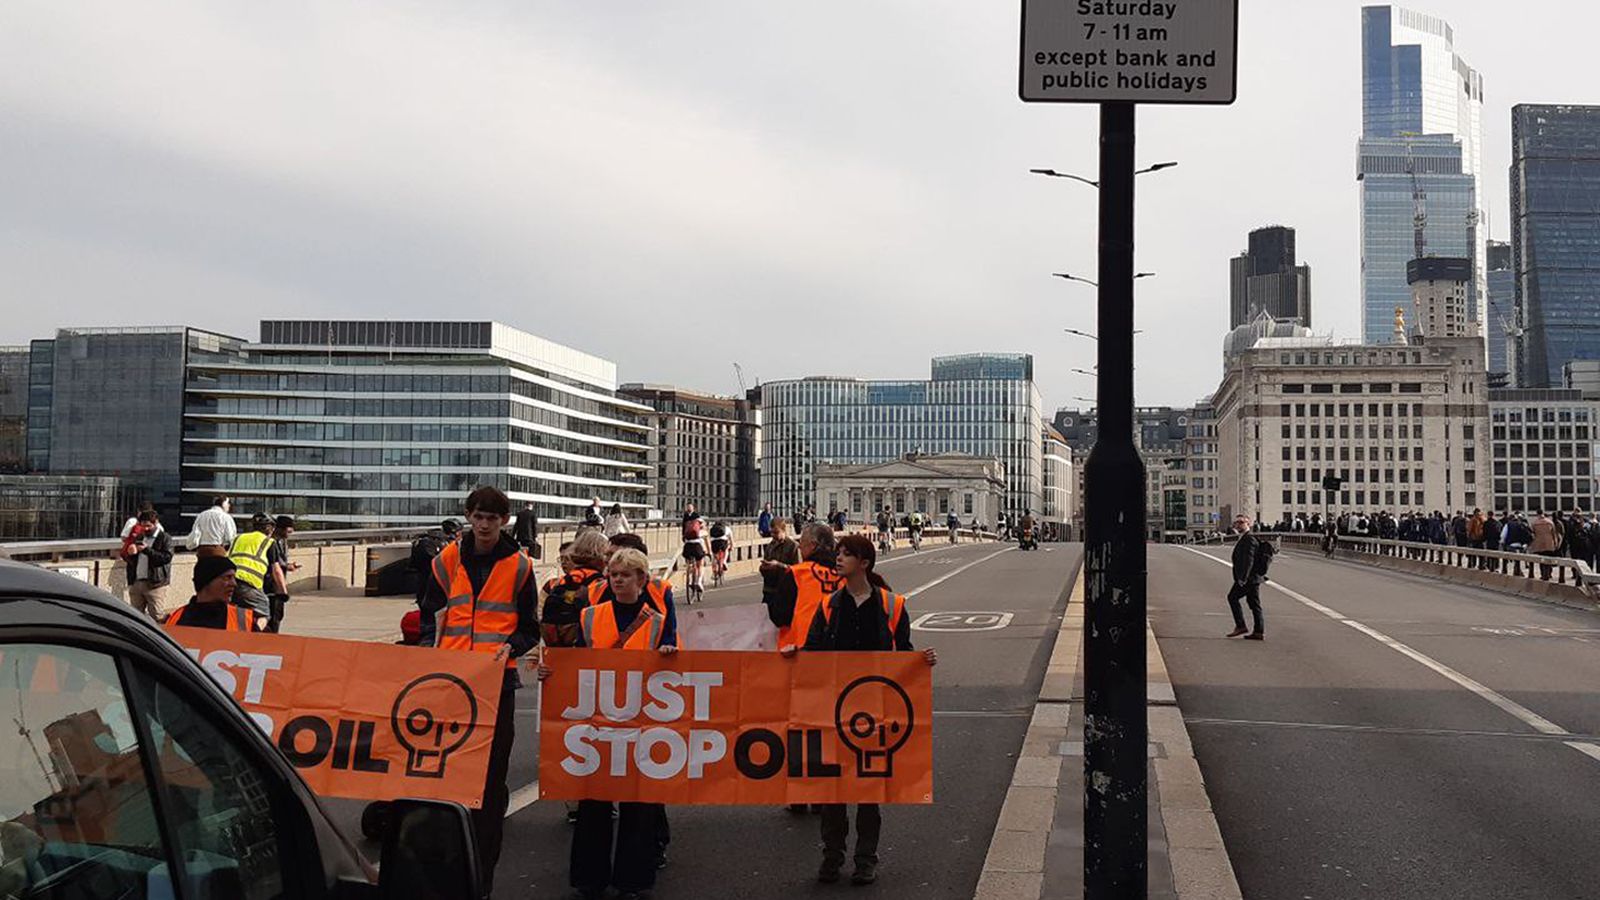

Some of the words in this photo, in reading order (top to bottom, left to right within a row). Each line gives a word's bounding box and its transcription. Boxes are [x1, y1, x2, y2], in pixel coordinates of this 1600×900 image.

[1077, 0, 1176, 20] Saturday
[1136, 27, 1167, 41] am
[1034, 51, 1107, 69] except
[1115, 49, 1168, 66] bank
[1176, 50, 1216, 67] and
[1042, 71, 1109, 90] public
[1117, 72, 1207, 93] holidays
[924, 614, 1000, 625] 20
[185, 647, 283, 704] ST
[561, 668, 723, 723] JUST
[278, 714, 390, 773] OIL
[560, 724, 728, 780] STOP
[733, 727, 842, 780] OIL
